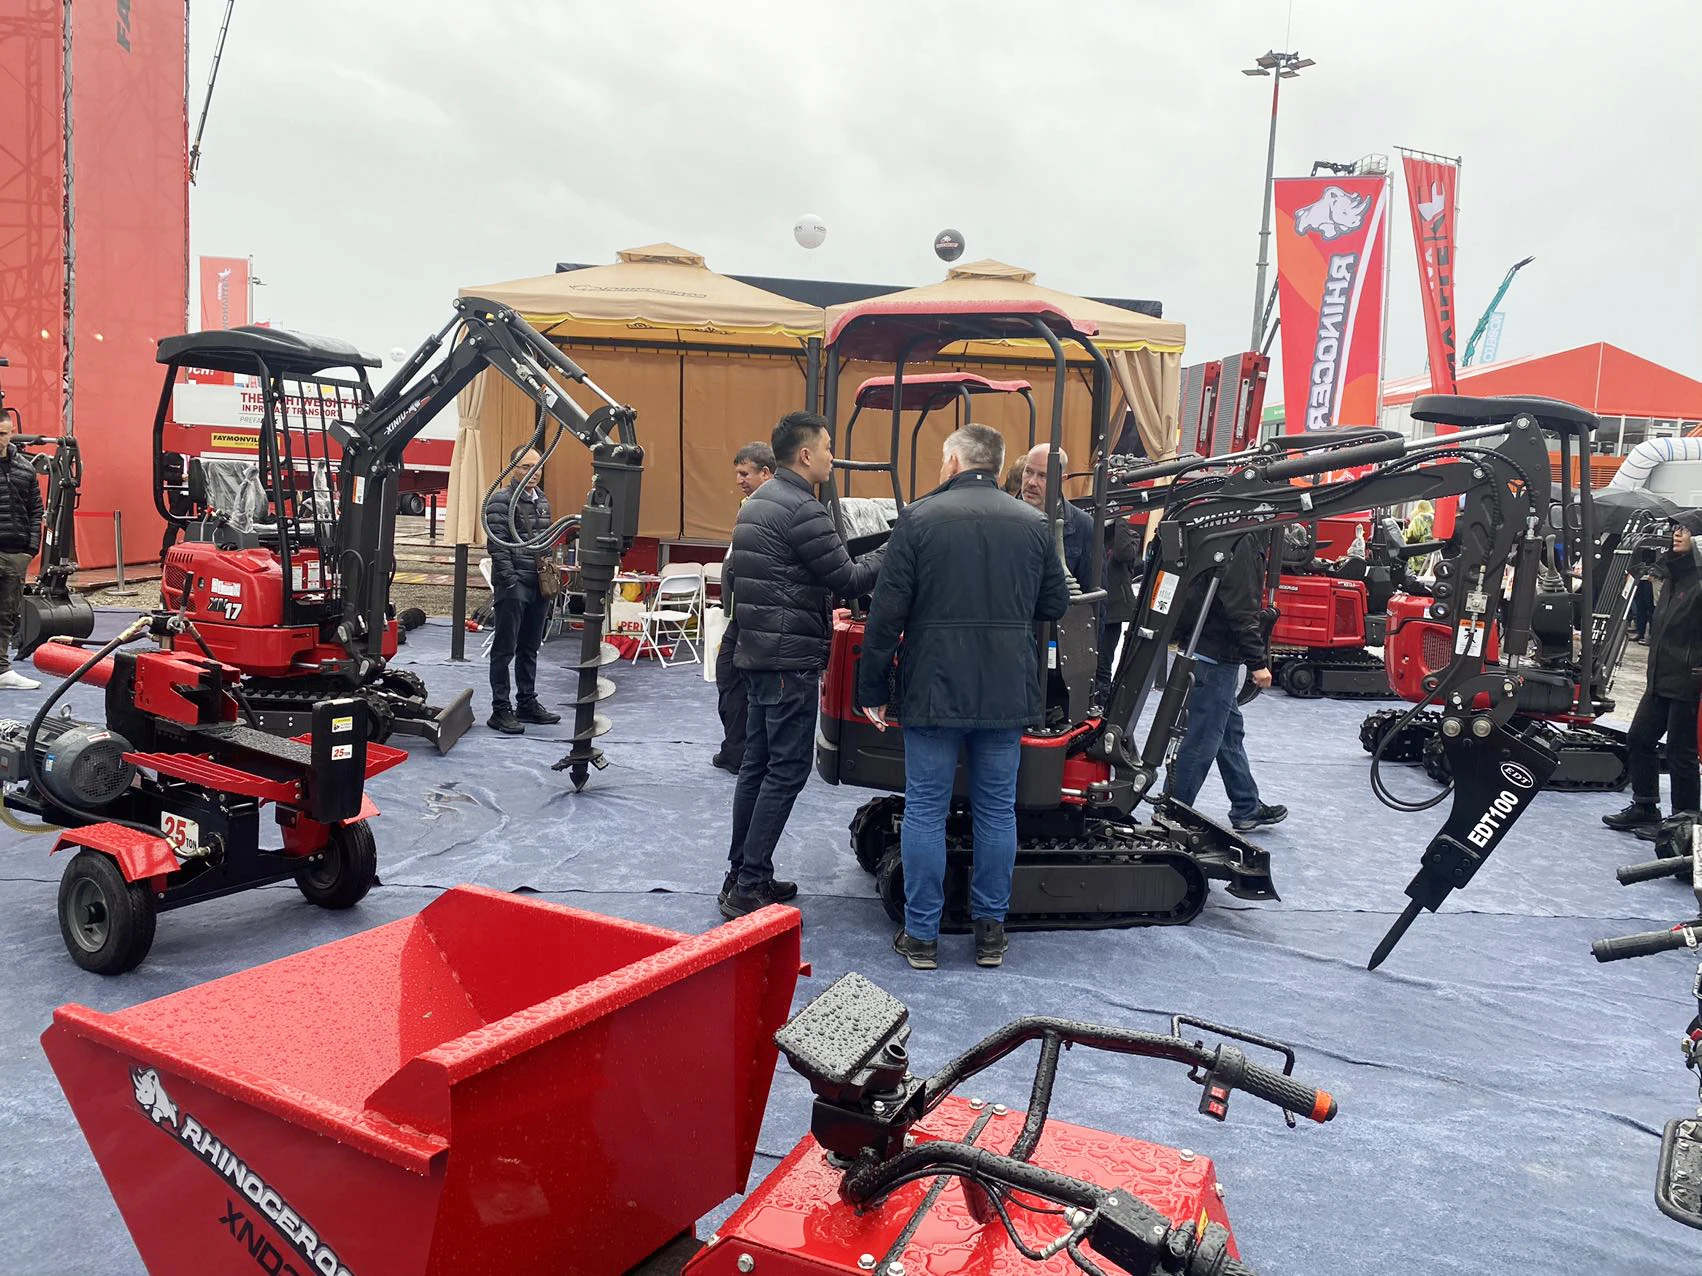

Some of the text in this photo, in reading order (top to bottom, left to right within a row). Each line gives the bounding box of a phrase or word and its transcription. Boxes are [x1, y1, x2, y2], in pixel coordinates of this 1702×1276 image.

[1504, 767, 1531, 784] EDT
[165, 816, 187, 847] 25
[1467, 790, 1519, 848] EDT100
